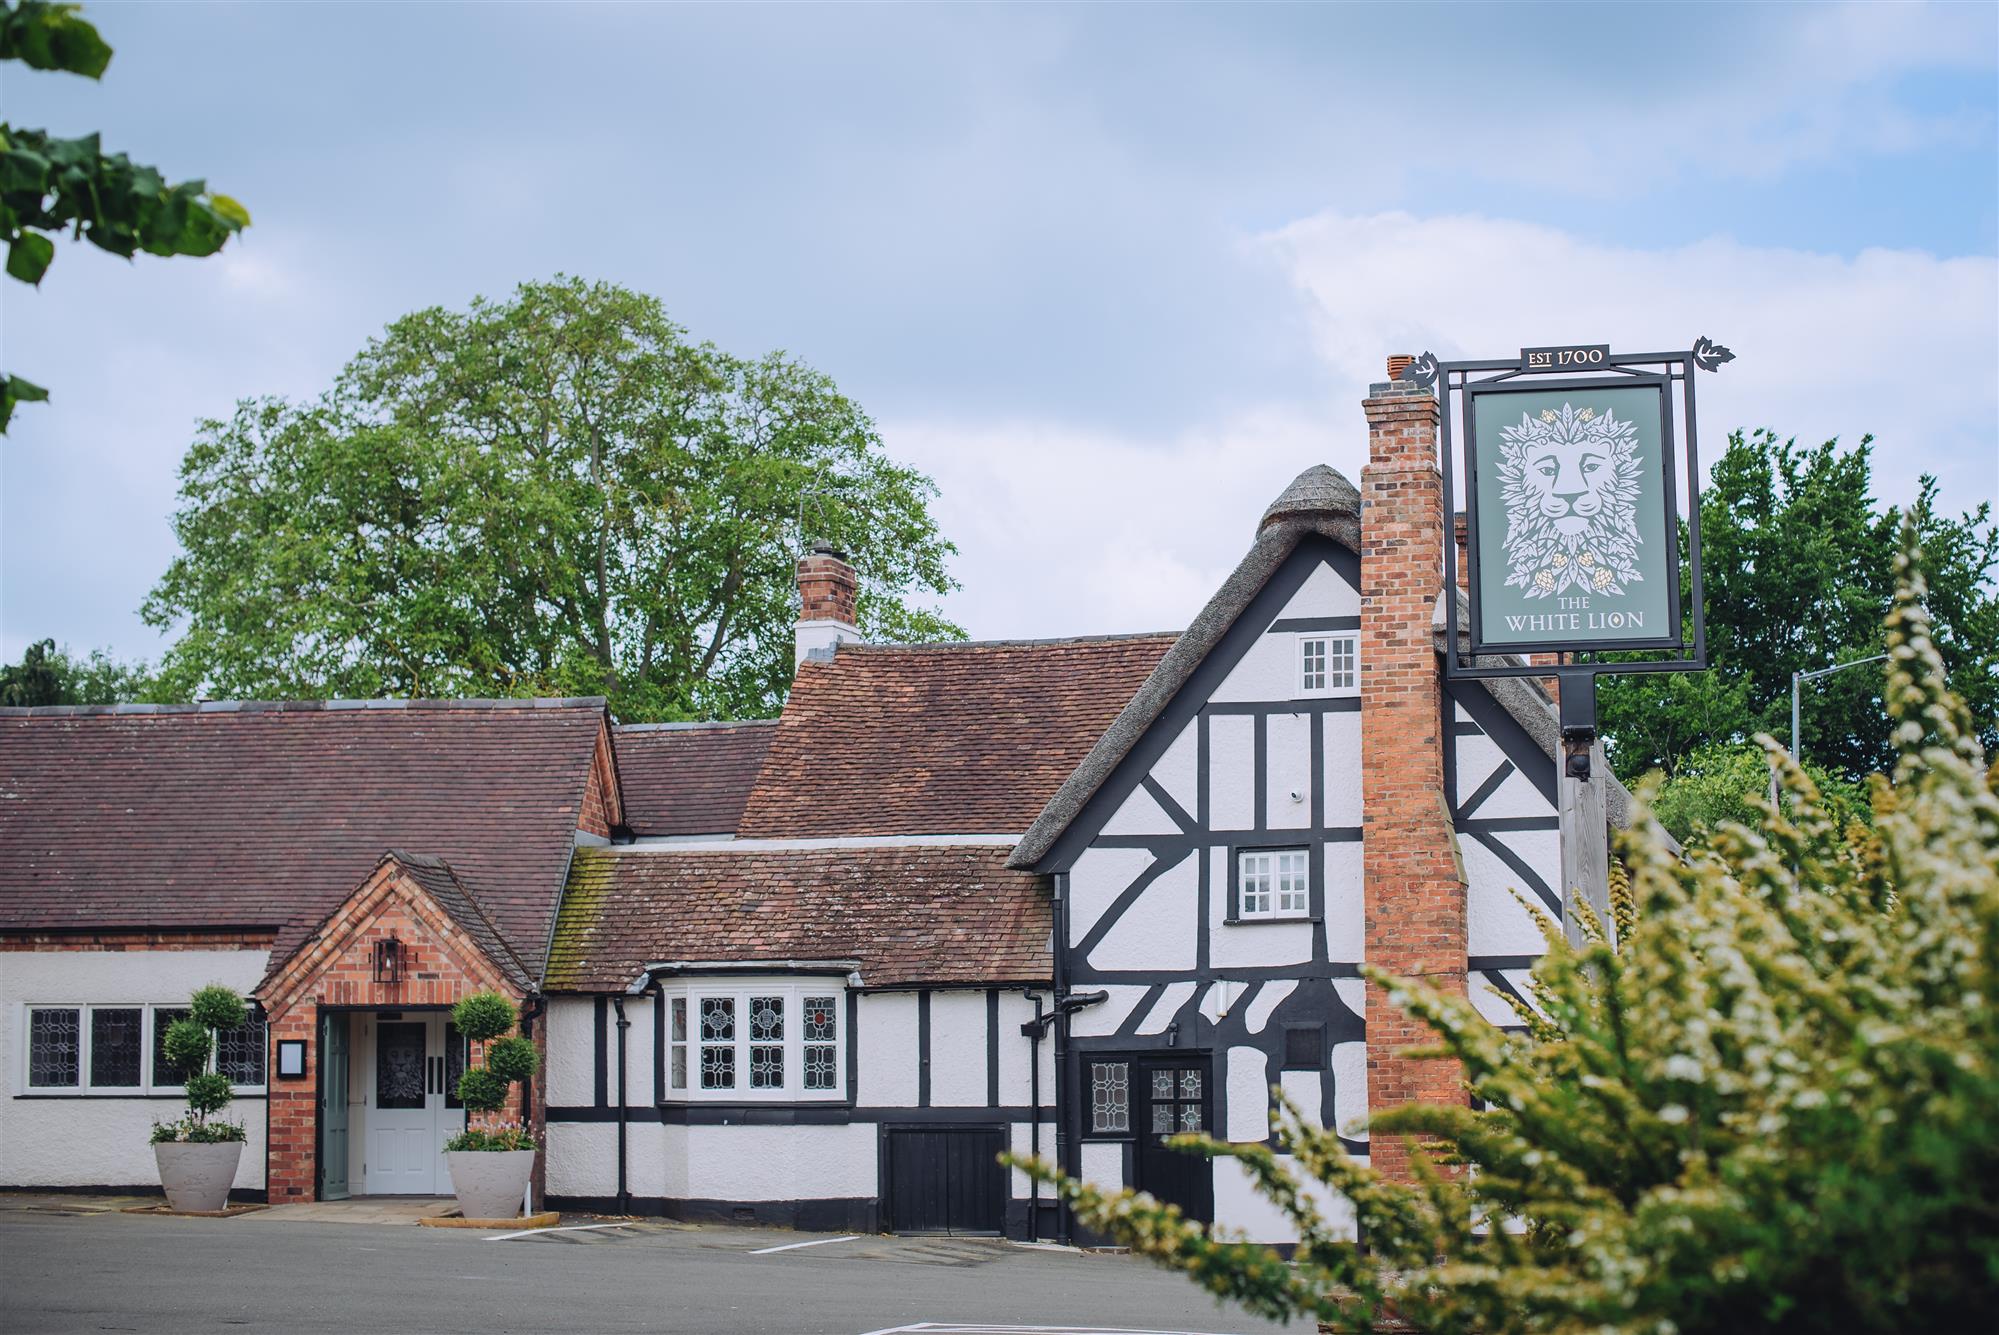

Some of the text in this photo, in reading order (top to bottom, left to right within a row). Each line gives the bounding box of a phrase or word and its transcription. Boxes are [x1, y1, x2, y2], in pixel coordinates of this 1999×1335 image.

[1528, 349, 1603, 365] EST 1700
[1557, 596, 1591, 610] THE
[1504, 611, 1644, 632] WHITE LION
